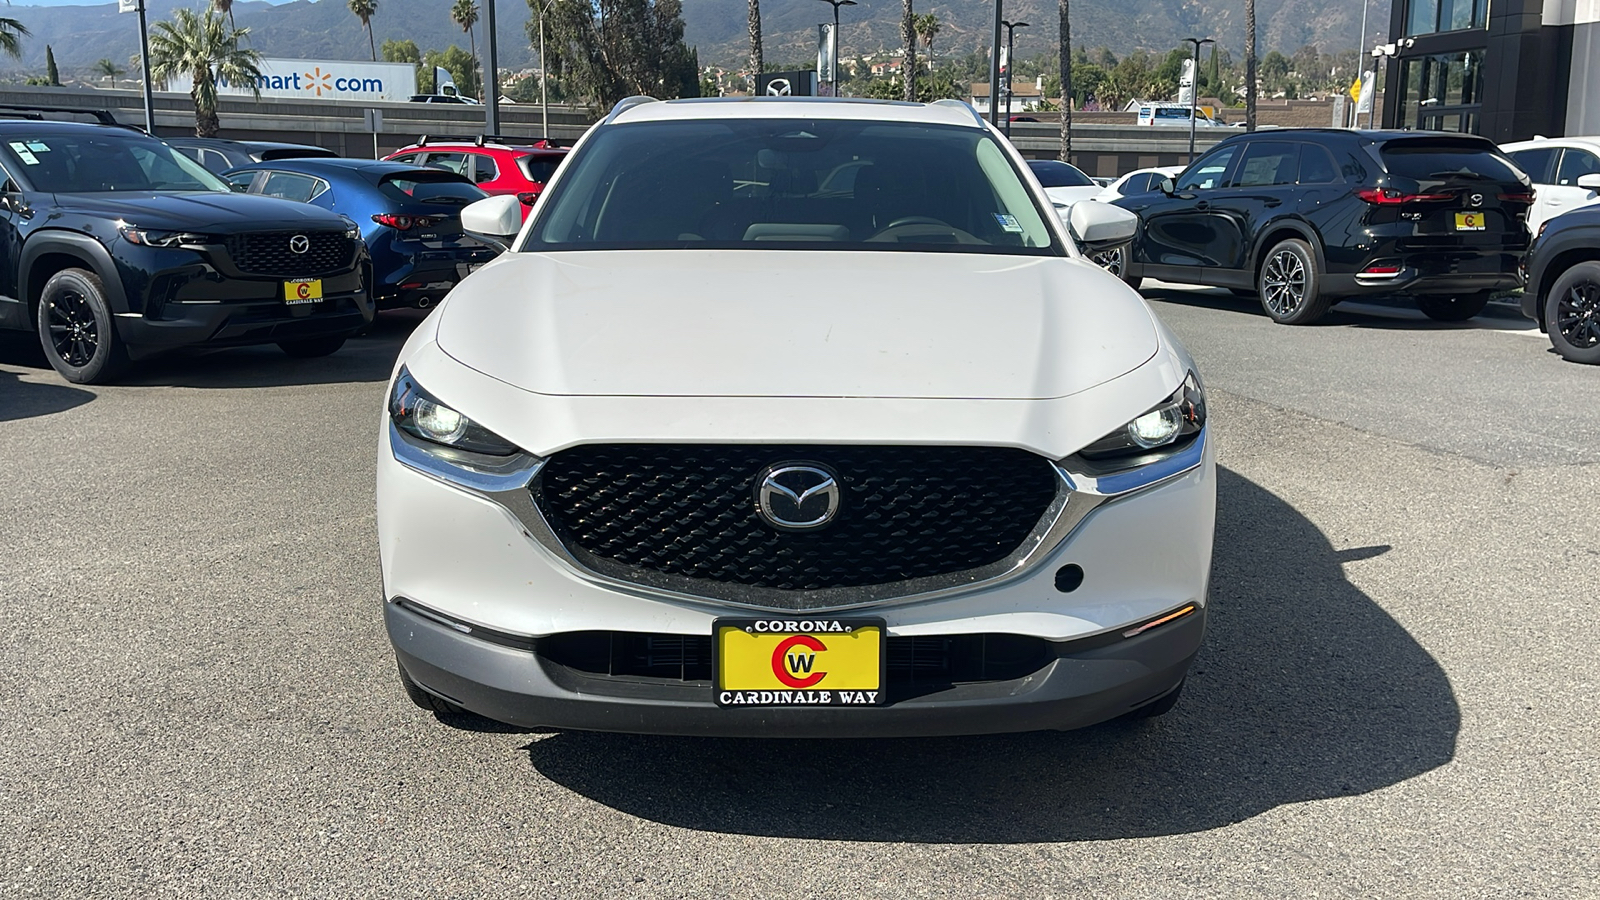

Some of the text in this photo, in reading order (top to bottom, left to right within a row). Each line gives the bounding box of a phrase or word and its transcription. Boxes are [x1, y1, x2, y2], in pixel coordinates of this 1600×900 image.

[335, 77, 383, 93] com
[754, 620, 844, 632] CORONA
[771, 634, 829, 689] C
[787, 652, 817, 674] W
[719, 691, 879, 705] CARDINALE WAY
